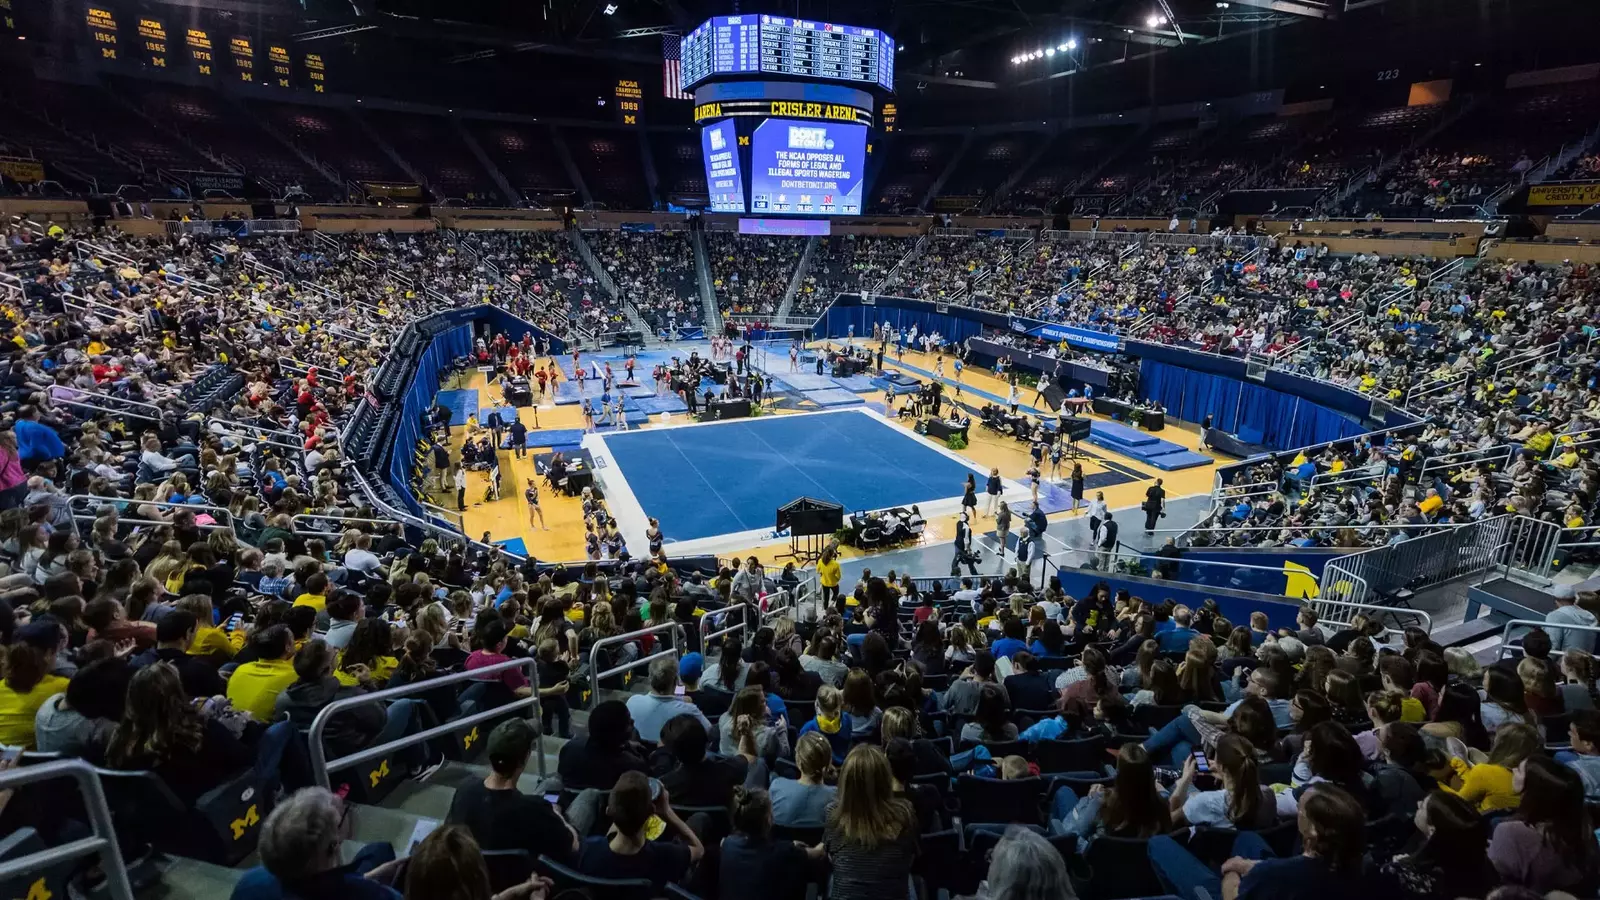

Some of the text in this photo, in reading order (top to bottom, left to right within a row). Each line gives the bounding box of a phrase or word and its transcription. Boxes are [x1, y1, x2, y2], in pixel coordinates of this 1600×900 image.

[88, 8, 112, 20] NCAA
[140, 19, 162, 29] NCAA
[94, 31, 117, 44] 1964
[187, 29, 207, 38] NCAA
[145, 41, 166, 53] 1965
[231, 38, 249, 47] NCAA
[102, 47, 117, 59] M
[192, 50, 211, 61] 1976
[270, 46, 286, 55] NCAA
[152, 56, 166, 68] M
[198, 64, 211, 75] M
[274, 65, 289, 75] 2013
[1376, 68, 1400, 81] 223
[241, 71, 253, 82] M
[279, 78, 290, 87] M
[313, 83, 324, 93] M
[618, 80, 638, 88] NCAA
[620, 101, 638, 111] 1989
[700, 103, 722, 119] ARENA
[770, 101, 858, 121] CRISLER ARENA
[624, 114, 636, 125] M
[739, 136, 749, 145] M
[776, 151, 845, 163] THE NCAA OPPOSES ALL
[778, 160, 801, 168] FORMS
[801, 161, 810, 169] OF
[810, 162, 829, 170] LEGAL
[767, 168, 851, 179] ILLEGAL SPORTS WAGERING
[781, 180, 837, 189] DONTBETONIT.ORG
[823, 195, 833, 204] N
[1042, 328, 1118, 349] WOMEN'S GYMNASTICS CHAMPIONSHIPS
[464, 726, 479, 750] M
[369, 759, 390, 788] M
[230, 803, 260, 841] M
